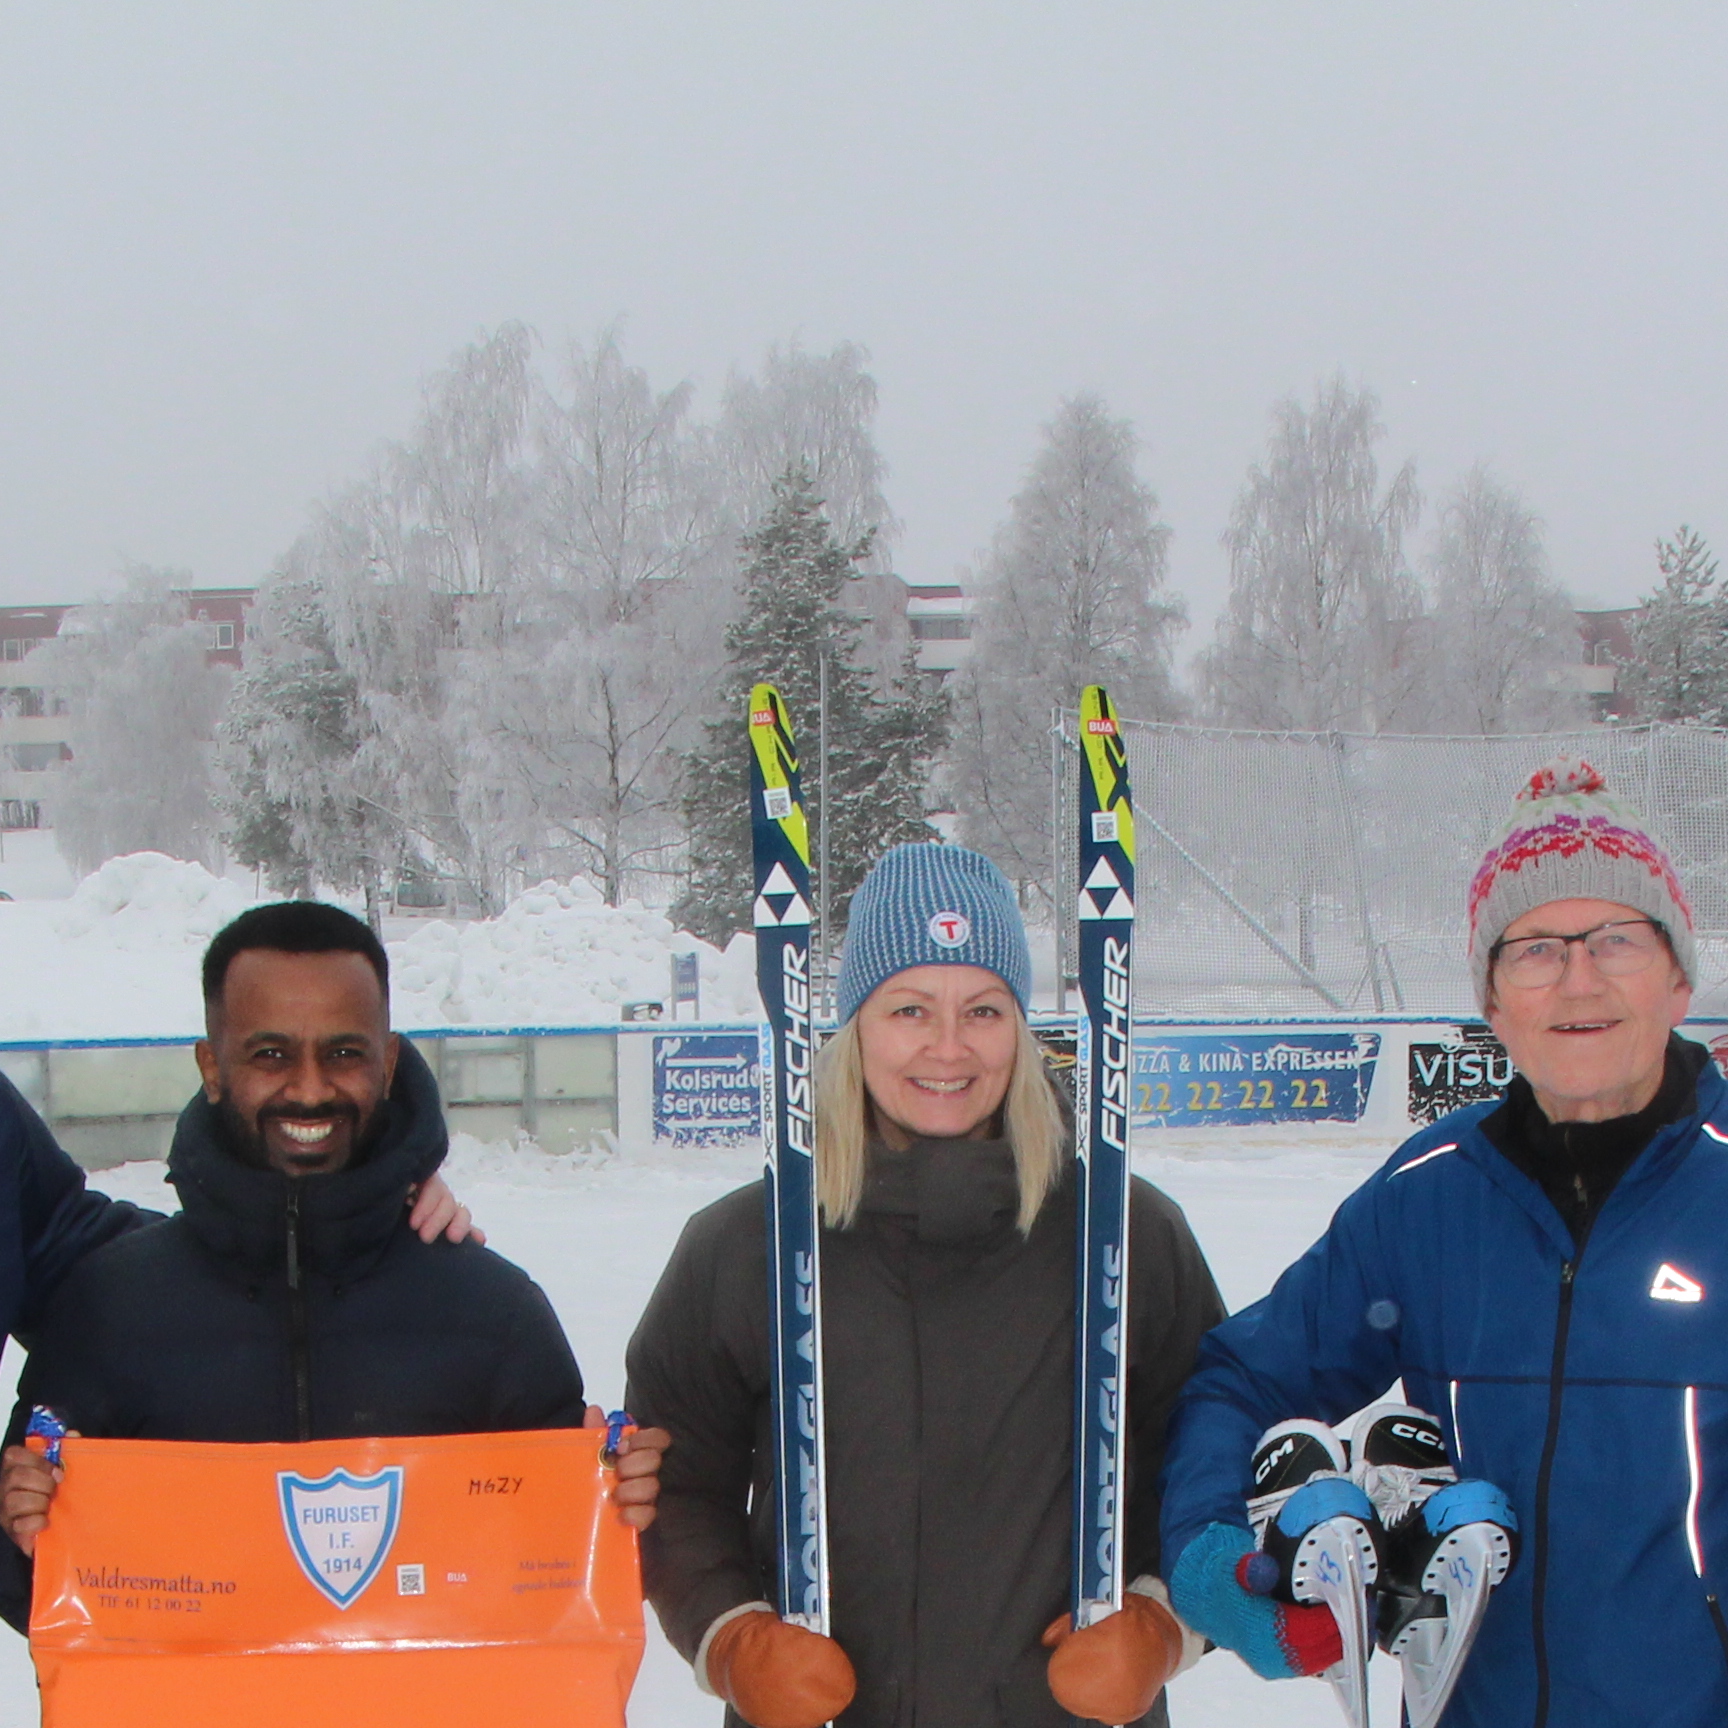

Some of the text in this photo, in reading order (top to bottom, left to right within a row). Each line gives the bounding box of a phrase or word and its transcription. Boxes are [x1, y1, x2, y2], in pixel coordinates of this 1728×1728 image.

[939, 921, 958, 939] T
[783, 942, 812, 1158] FISCHER
[1101, 937, 1129, 1152] FISCHER
[1131, 1053, 1170, 1073] IZZA
[1178, 1053, 1191, 1073] &
[662, 1093, 751, 1116] Services
[762, 1071, 774, 1123] SPORT
[1077, 1066, 1090, 1116] SPORT
[1137, 1078, 1329, 1112] 22 22 22 22
[303, 1505, 380, 1524] FURUSET
[76, 1566, 237, 1594] Valdresmatta.no
[323, 1557, 363, 1573] 1914
[1448, 1556, 1474, 1589] 43
